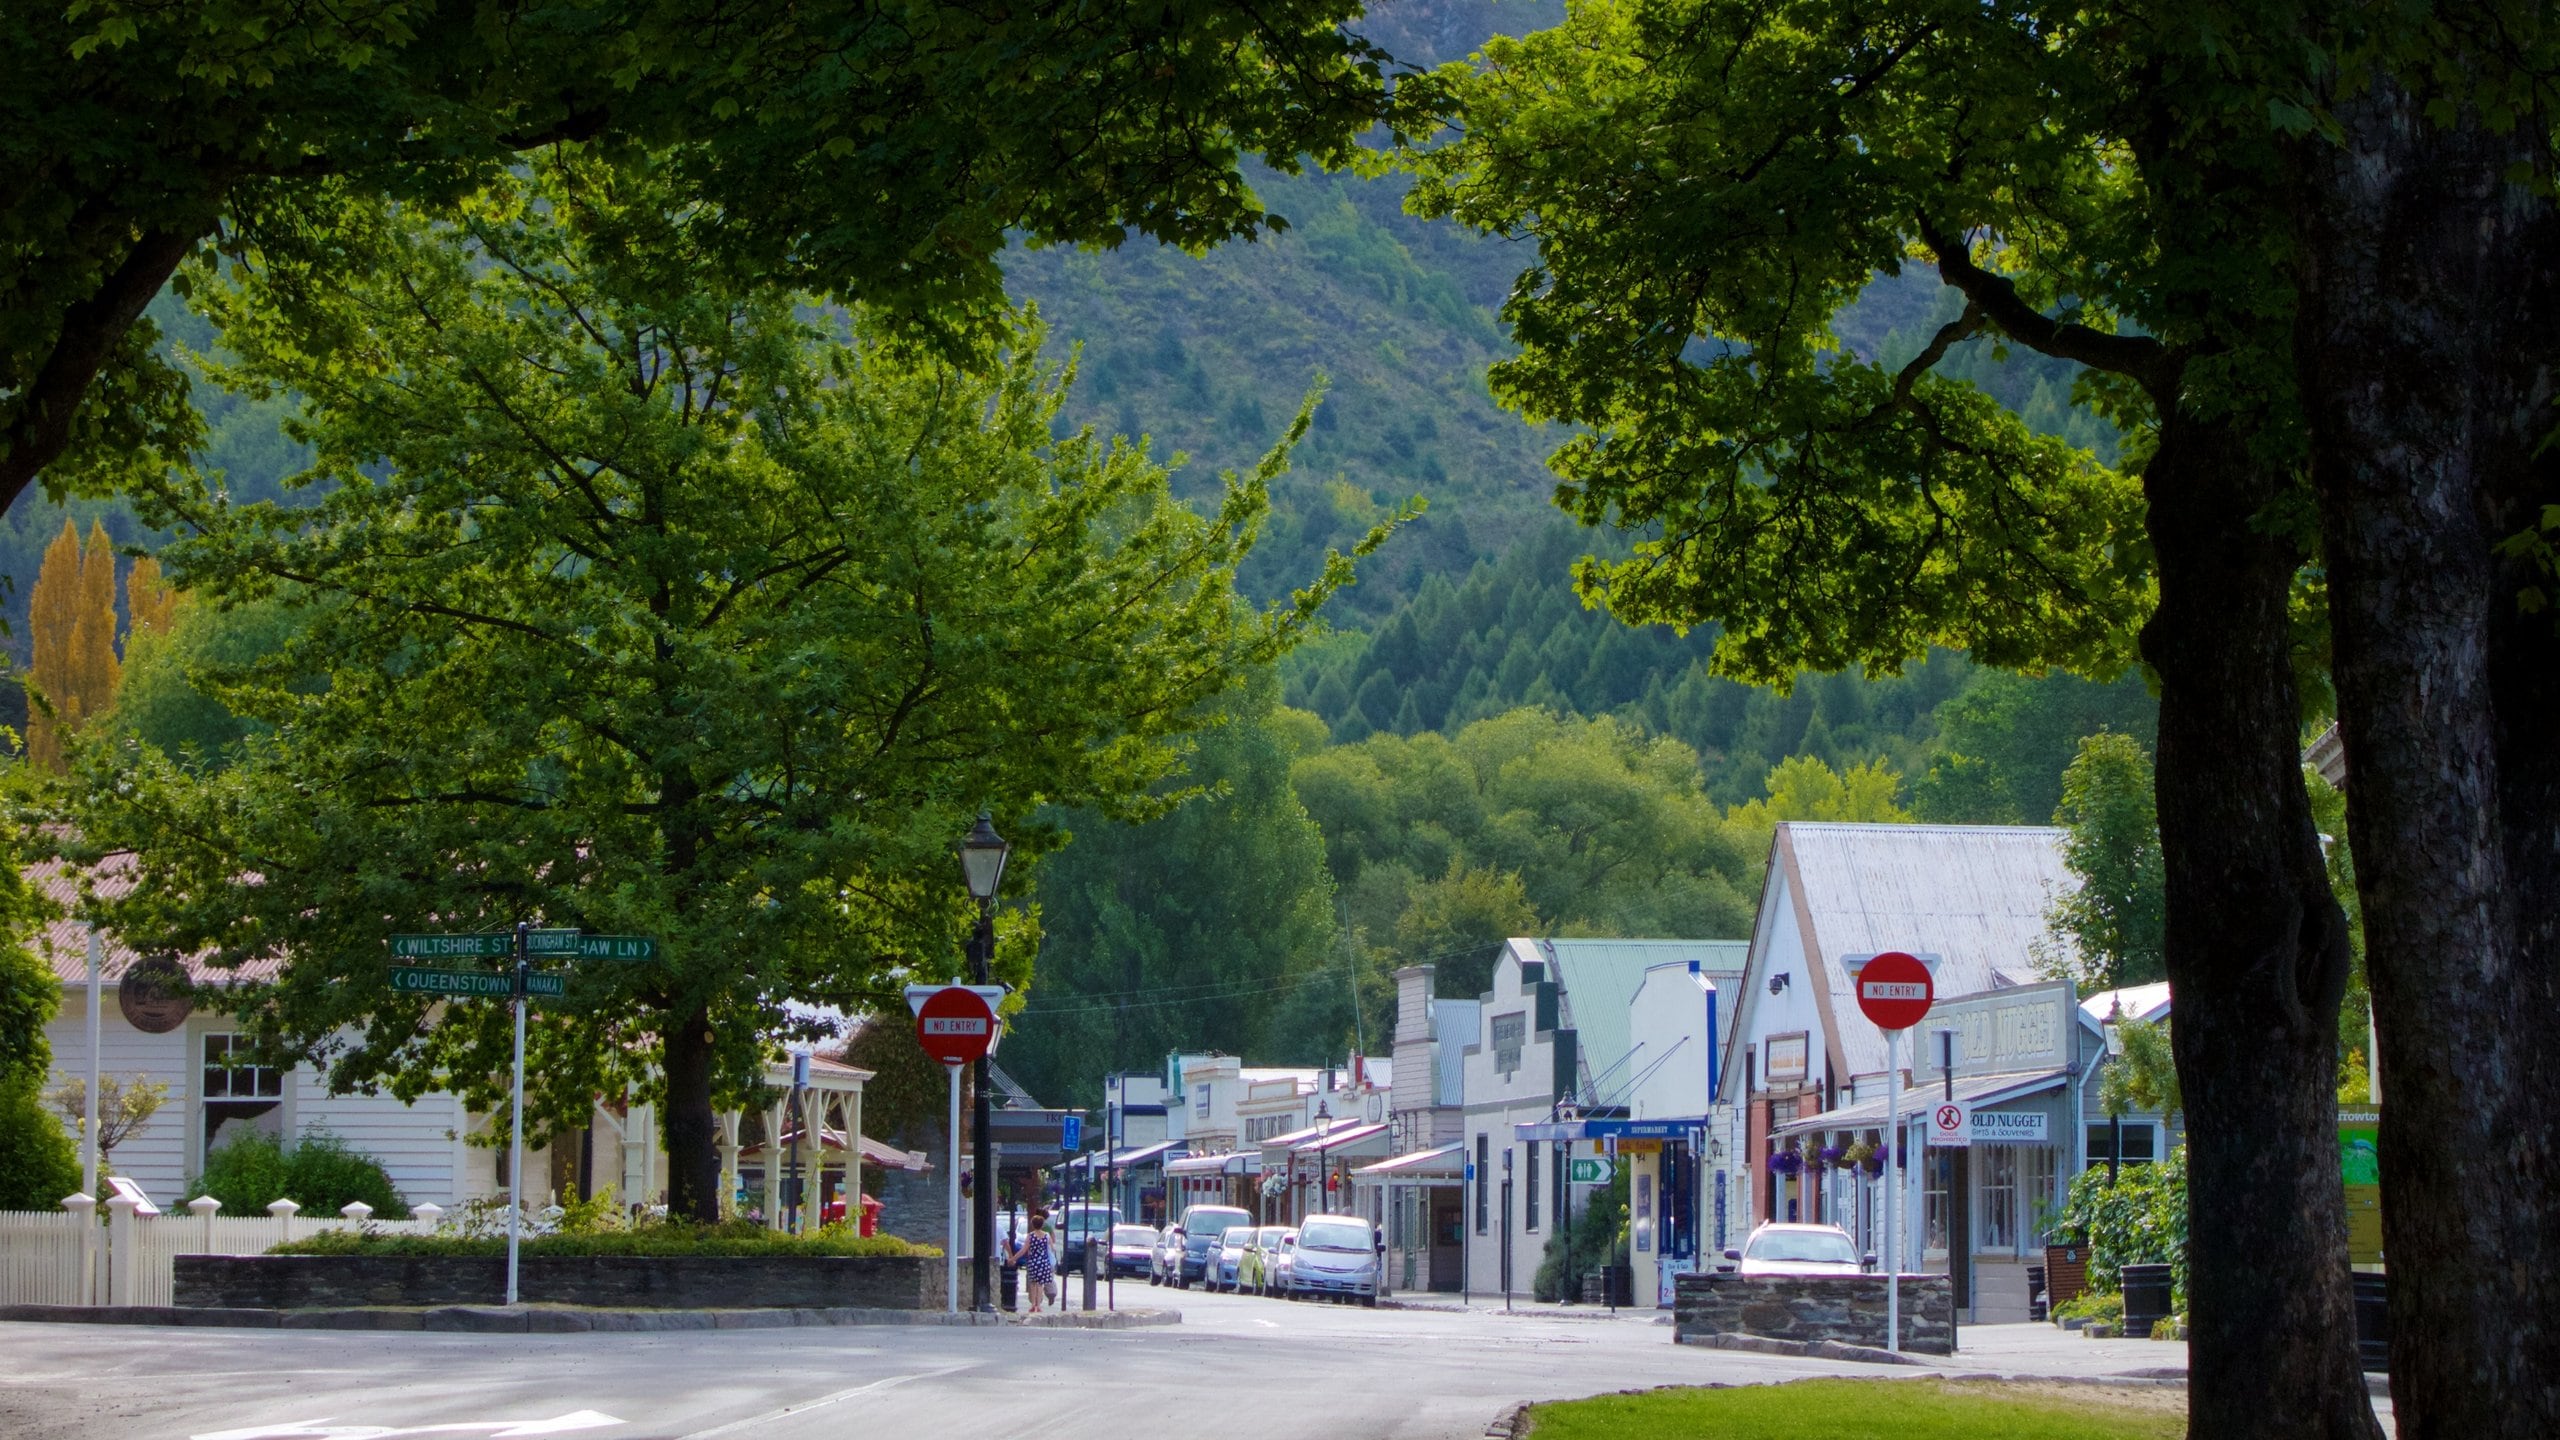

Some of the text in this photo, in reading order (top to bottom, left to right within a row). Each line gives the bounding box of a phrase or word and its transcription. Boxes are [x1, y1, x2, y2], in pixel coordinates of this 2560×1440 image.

[407, 937, 510, 953] WILTSHIRE ST
[565, 934, 573, 949] ST
[617, 942, 637, 956] LN
[407, 973, 511, 993] QUEENSTOWN
[1872, 985, 1917, 997] NO ENTRY
[933, 1021, 977, 1032] NO ENTRY
[1995, 1001, 2057, 1060] NUGGET
[1970, 1114, 2044, 1128] OLD NUGGET
